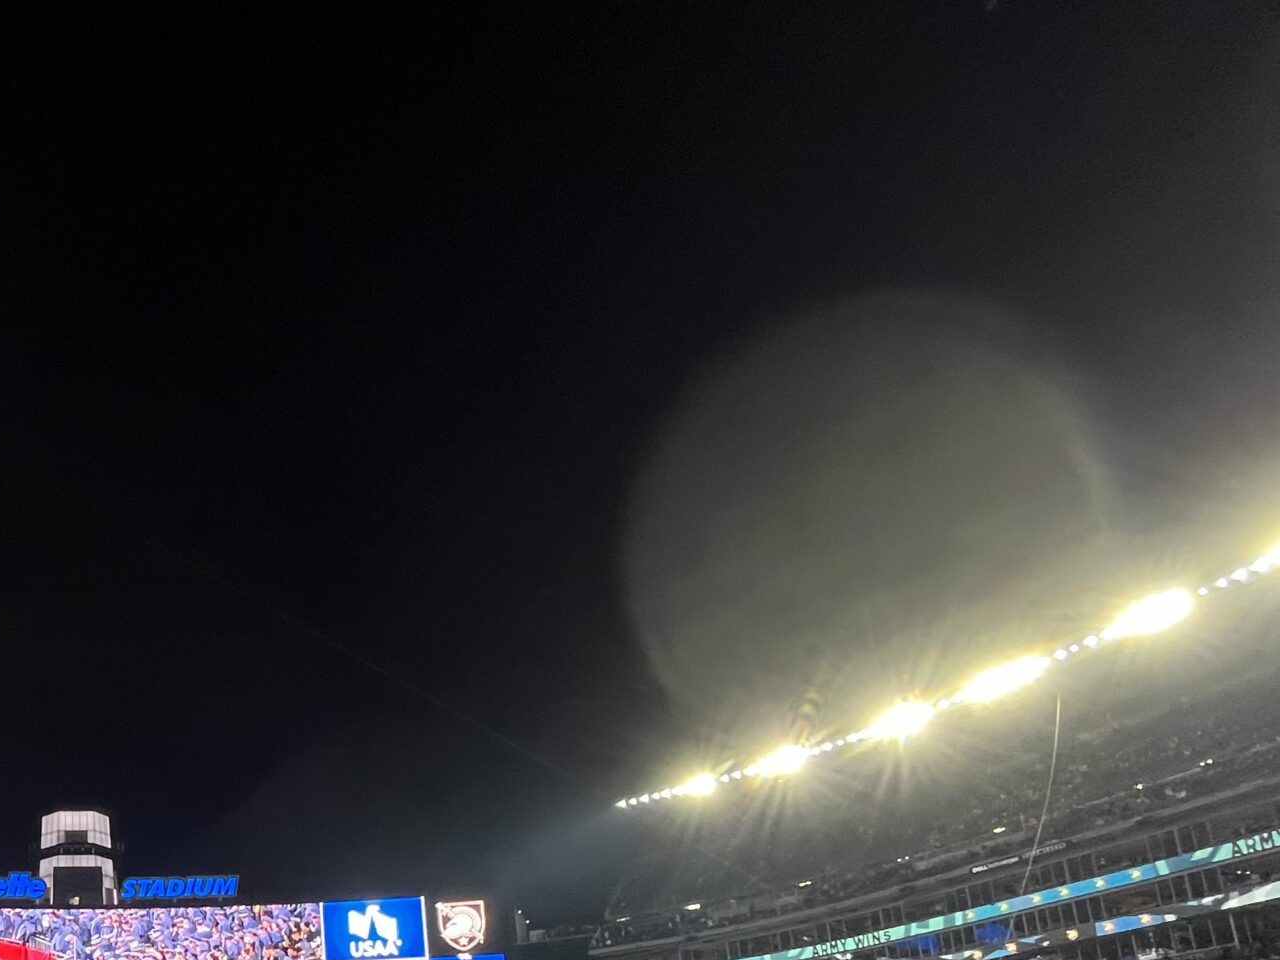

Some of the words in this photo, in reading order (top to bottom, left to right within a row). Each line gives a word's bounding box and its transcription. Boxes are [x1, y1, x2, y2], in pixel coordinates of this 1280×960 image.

[121, 876, 239, 899] STADIUM
[350, 939, 400, 958] USAA
[813, 939, 847, 957] ARMY
[854, 931, 891, 949] WINS
